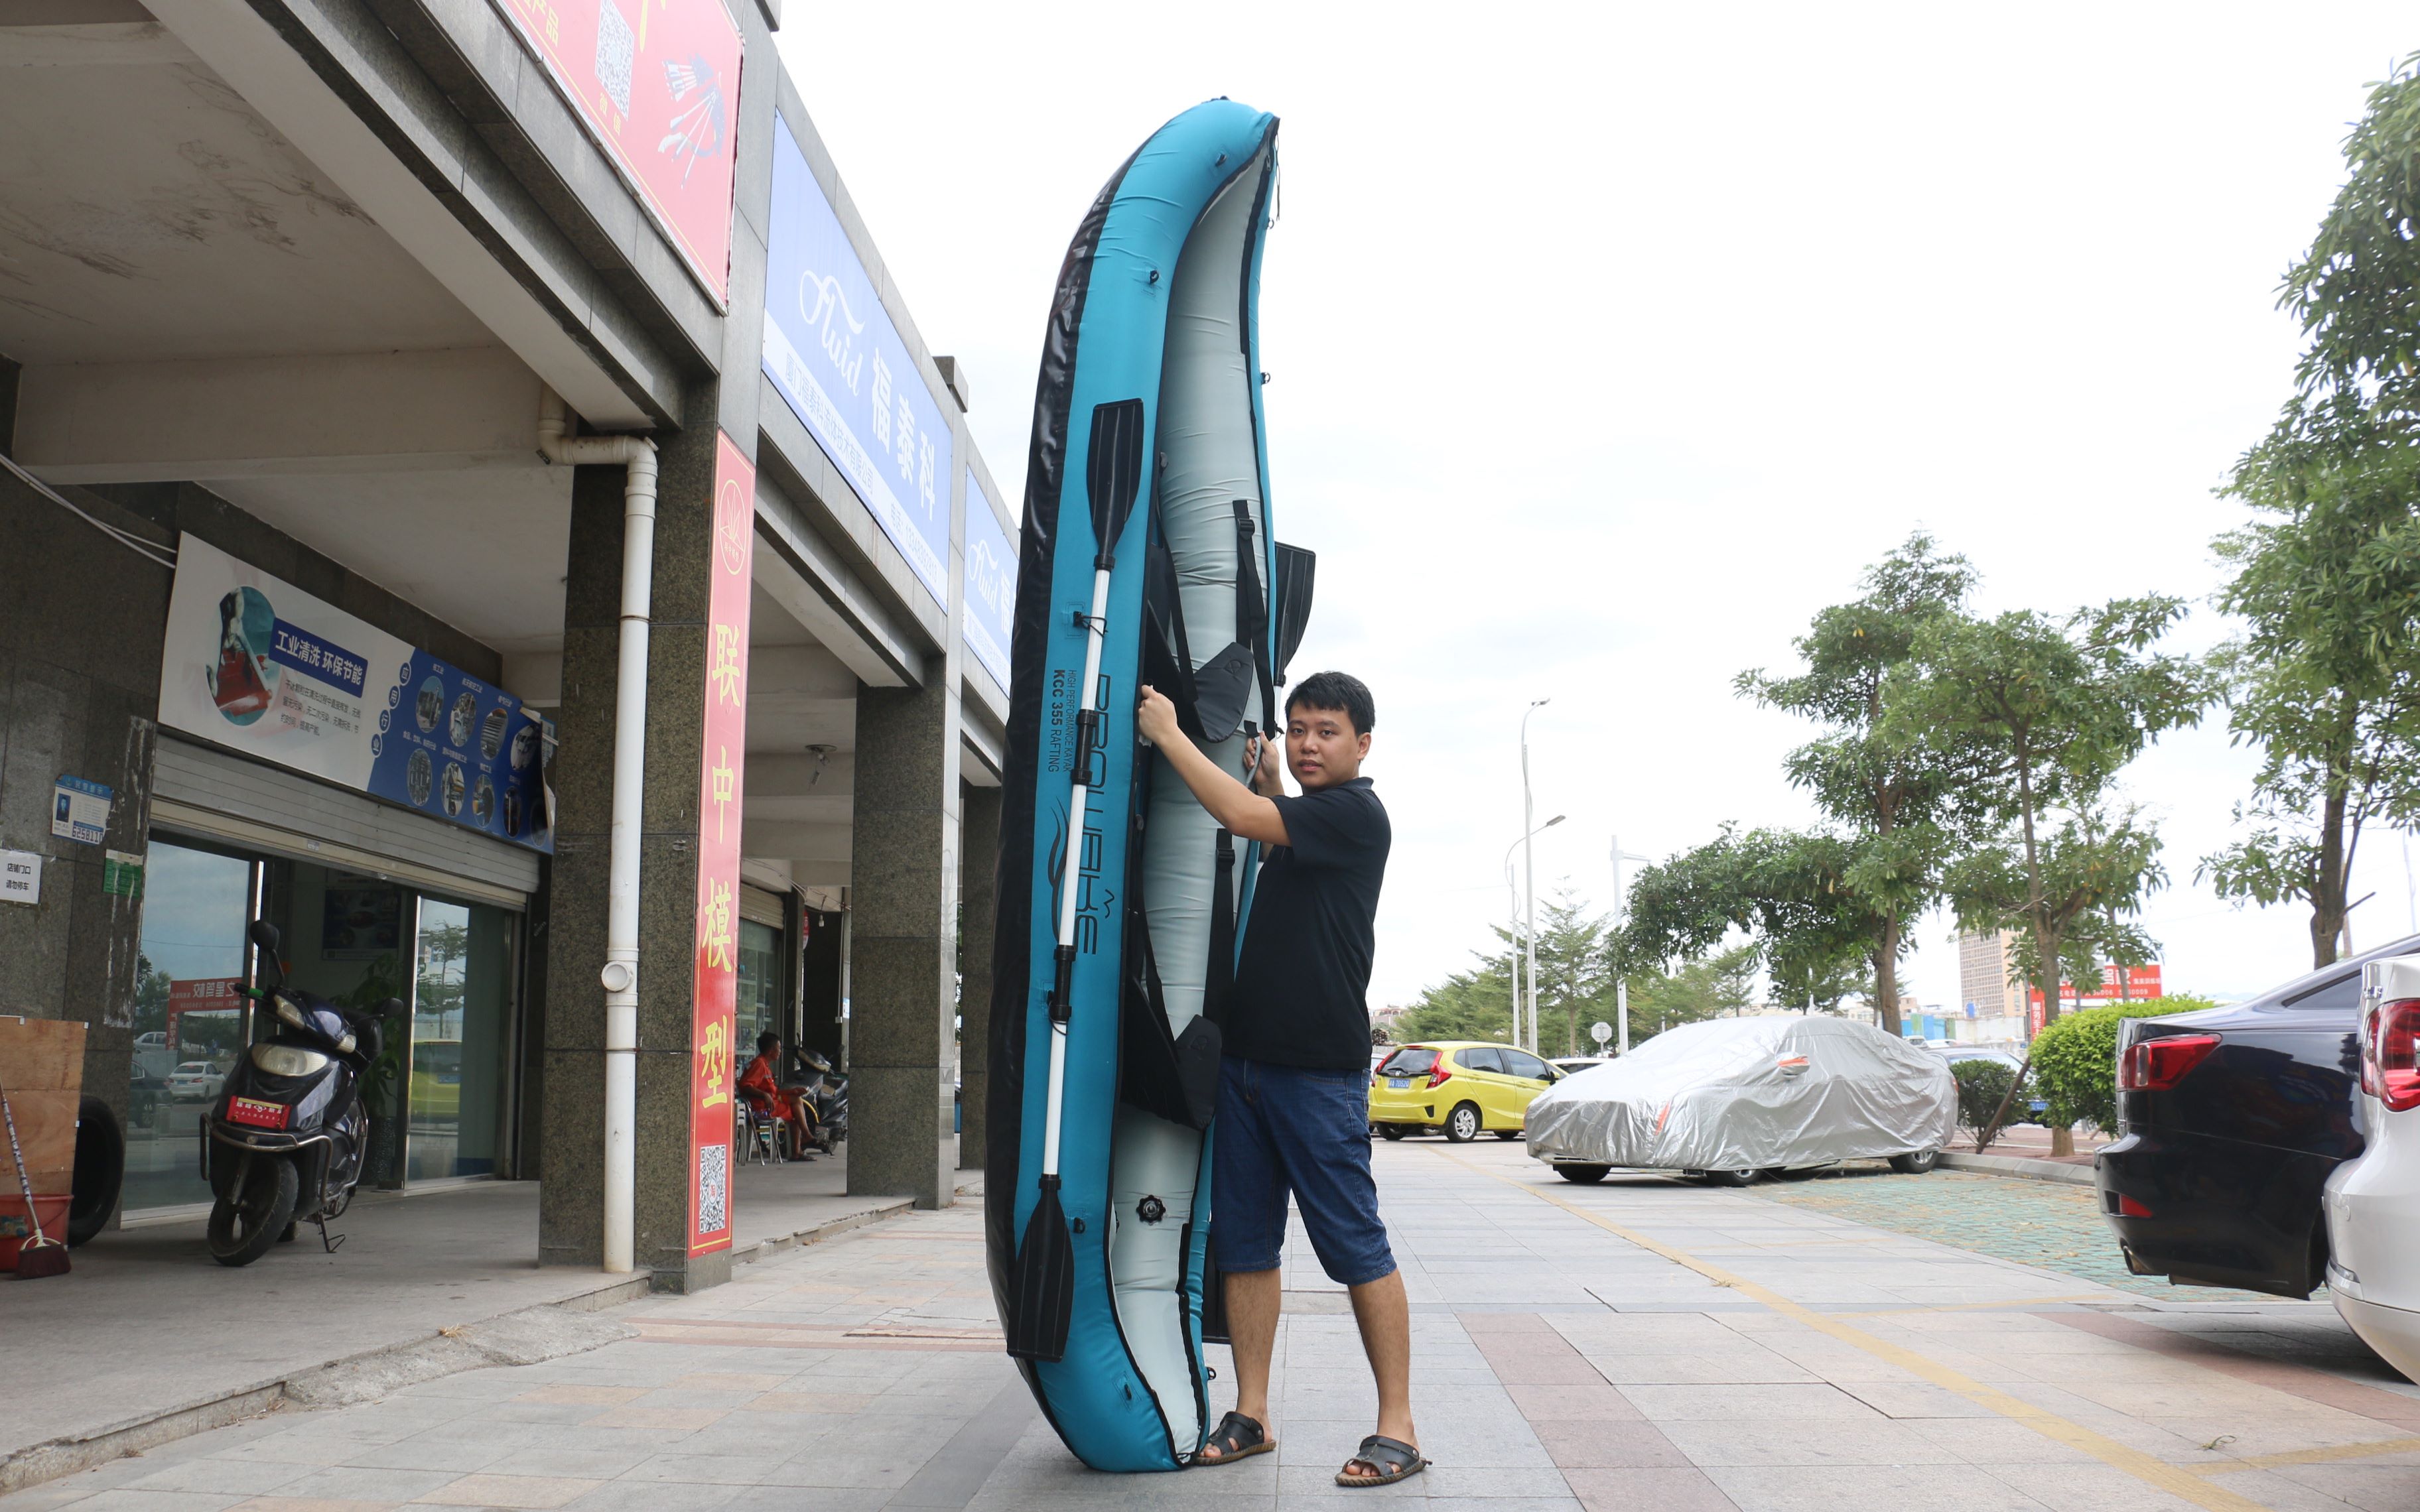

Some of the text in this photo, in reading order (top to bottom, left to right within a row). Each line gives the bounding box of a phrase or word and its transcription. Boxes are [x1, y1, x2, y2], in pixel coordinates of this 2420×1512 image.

[799, 269, 865, 397] Fluid
[785, 351, 874, 495] 厦门福泰科流体技术有限公司
[872, 347, 936, 521] 福泰科
[968, 538, 999, 615] Fluid
[275, 630, 363, 686] 工业清洗 环保节能
[1049, 670, 1065, 773] KCC 355 RAFTING
[1063, 670, 1077, 772] HIGH PERFORMANCE KAYAK
[6, 880, 29, 891] 请勿停车
[7, 863, 31, 875] 店铺门口
[701, 624, 740, 1107] 联中模型
